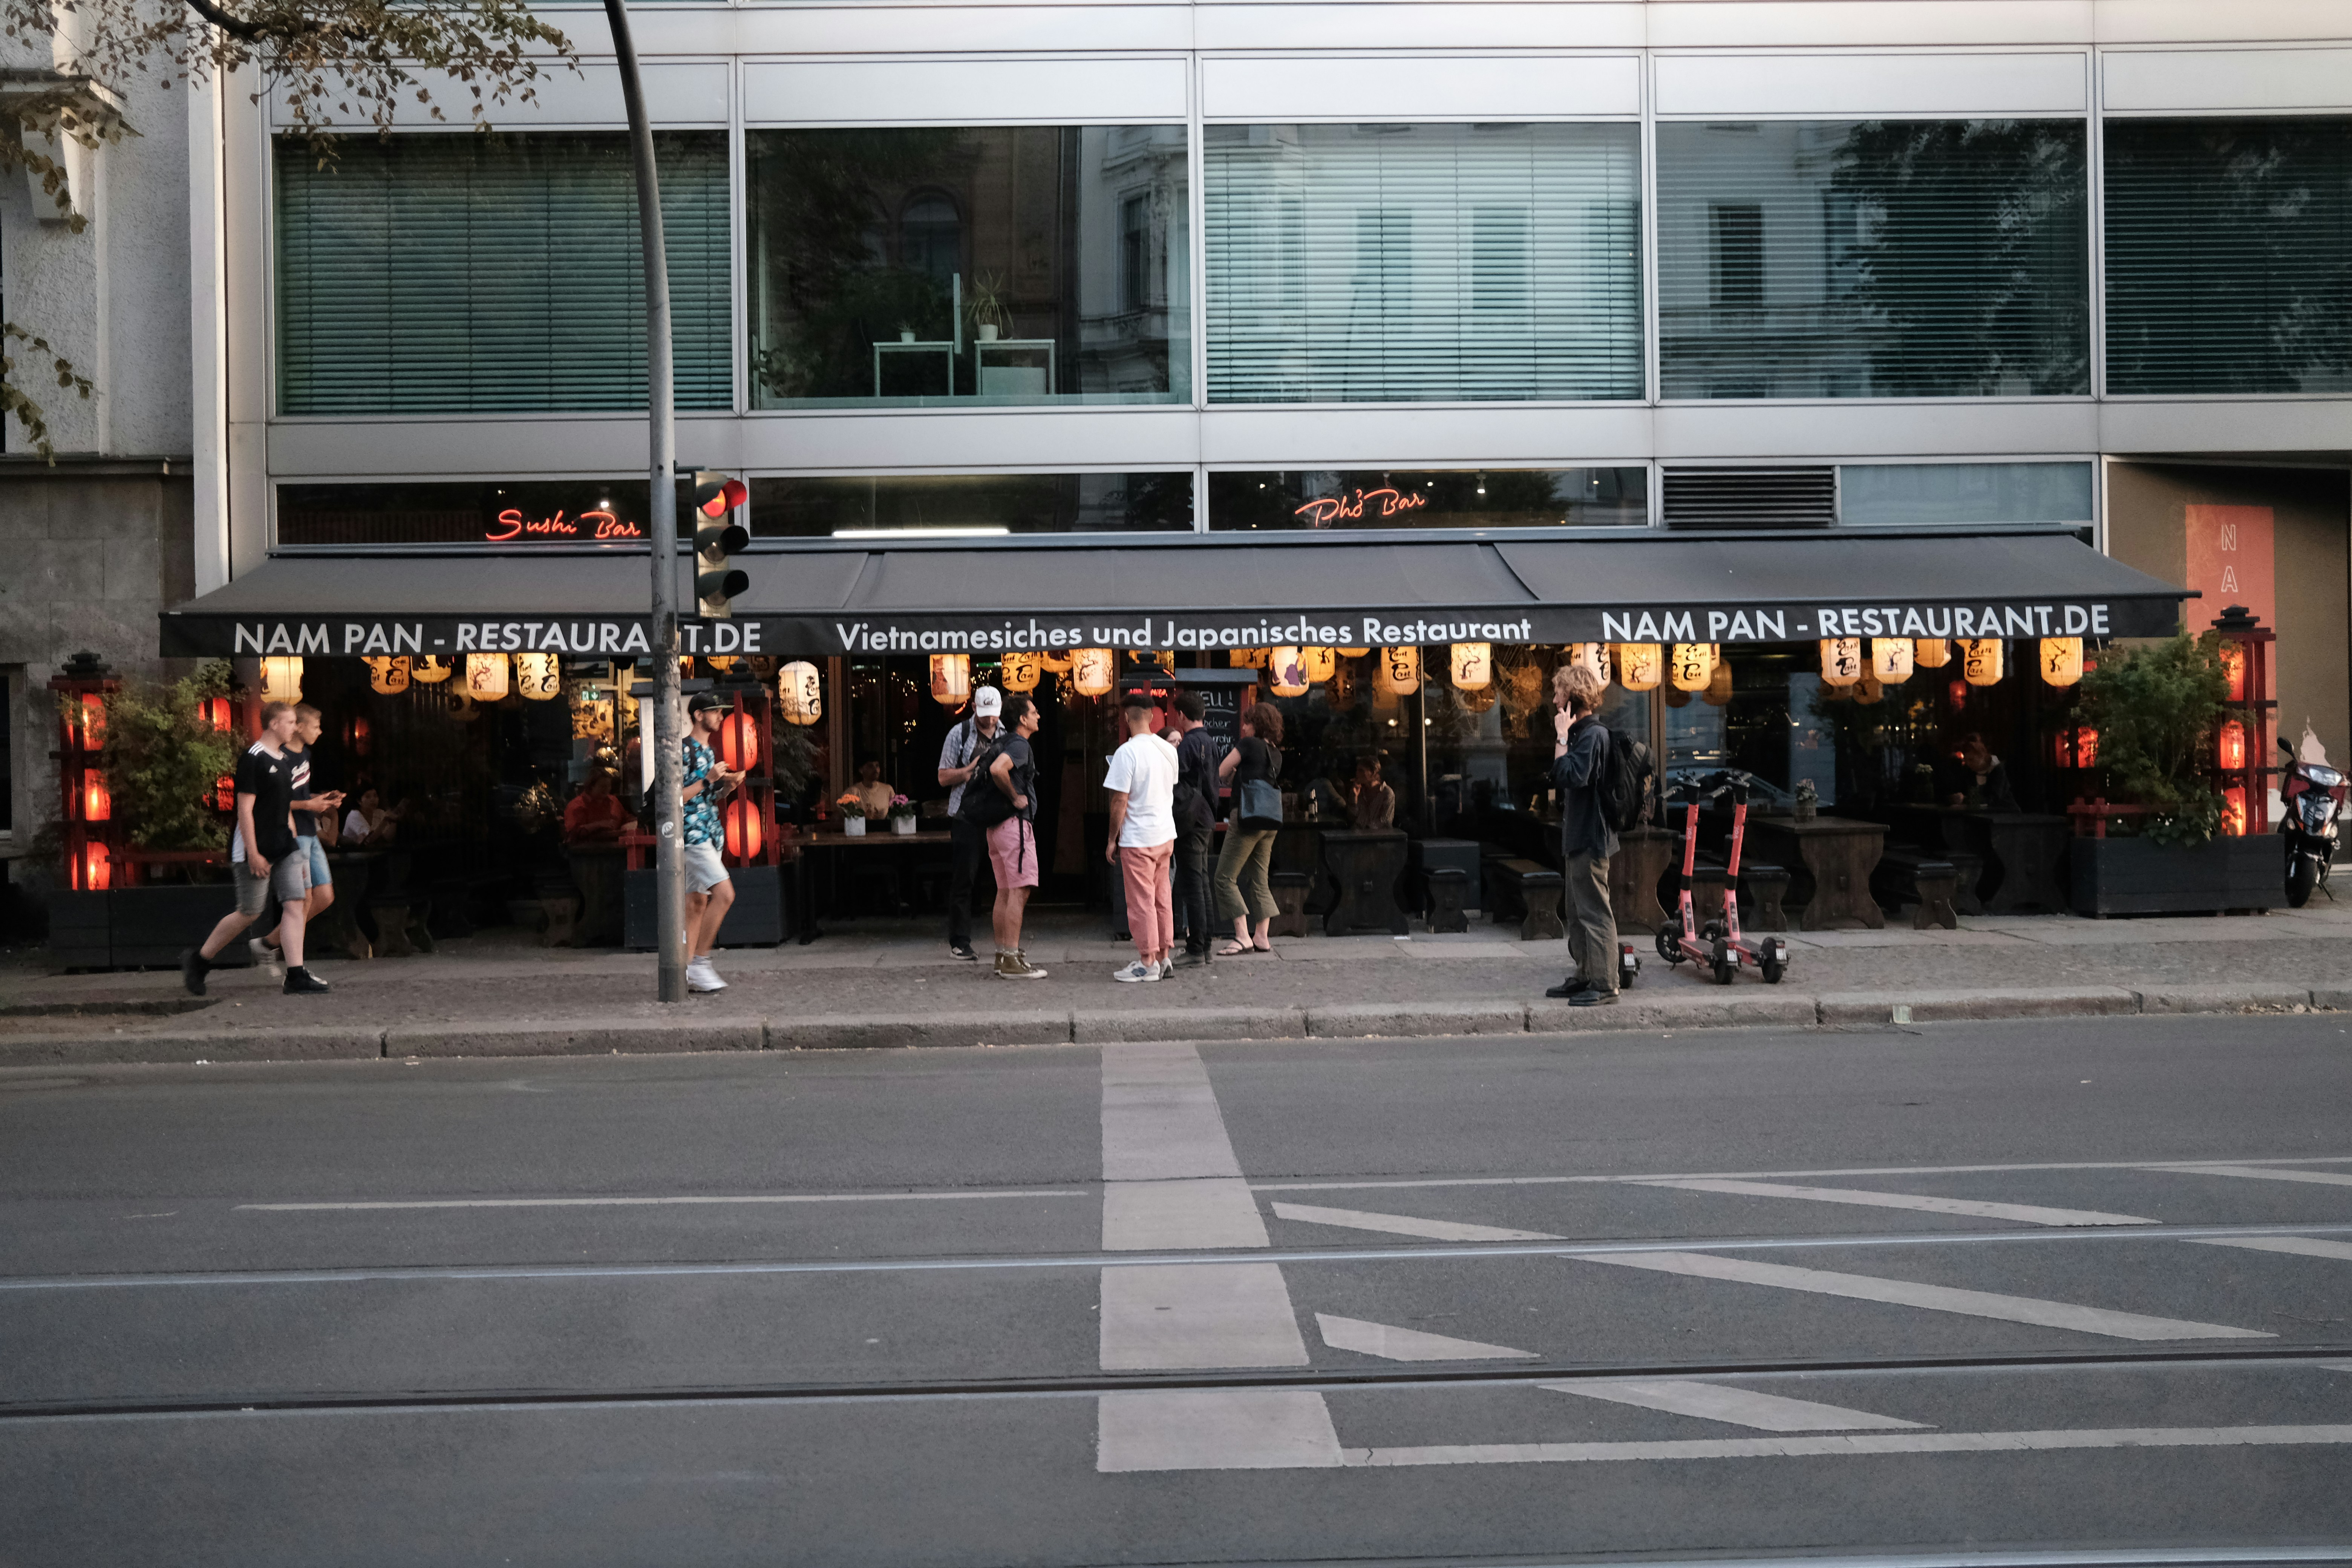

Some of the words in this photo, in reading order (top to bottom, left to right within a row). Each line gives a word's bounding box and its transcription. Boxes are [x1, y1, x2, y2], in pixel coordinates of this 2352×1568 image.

[1364, 489, 1425, 516] Bar
[486, 509, 577, 541] Sushi
[581, 511, 641, 539] Bar
[234, 623, 330, 654] NAM
[344, 624, 423, 654] PAN
[456, 622, 761, 653] RESTAURAT.DE
[836, 618, 1082, 651] Vietnamesiches
[1093, 618, 1151, 646] und
[1161, 615, 1352, 650] Japanisches
[1363, 617, 1531, 643] Restaurant
[1602, 611, 1696, 642] NAM
[1708, 610, 1786, 640] PAN
[1818, 605, 2110, 637] RESTAURANT.DE
